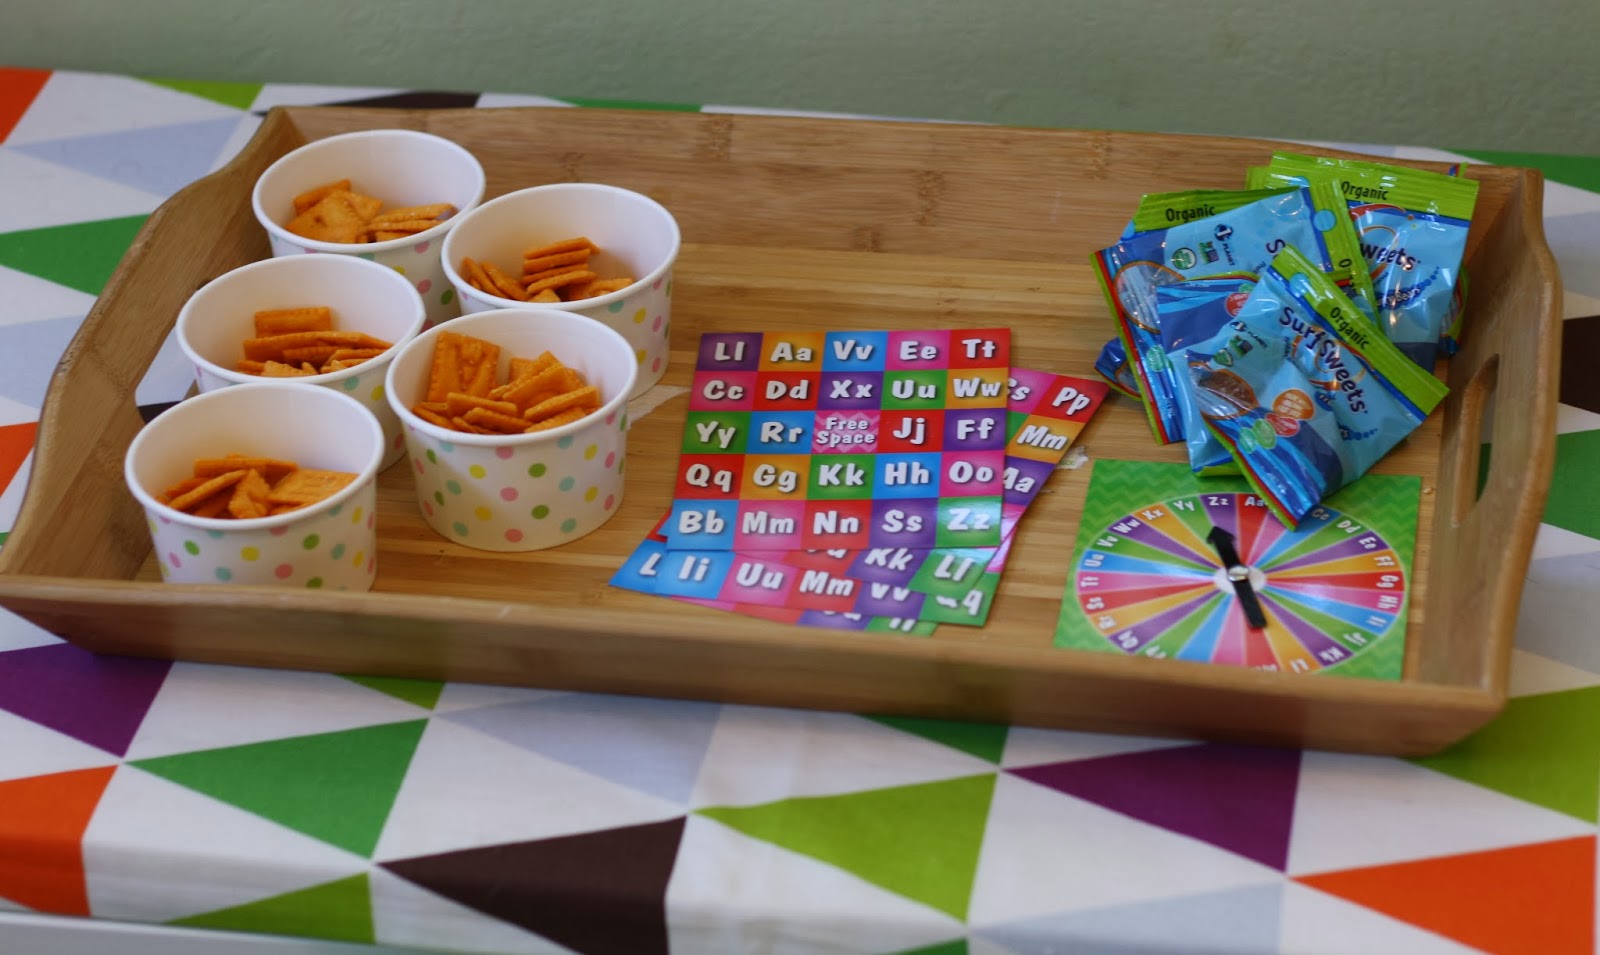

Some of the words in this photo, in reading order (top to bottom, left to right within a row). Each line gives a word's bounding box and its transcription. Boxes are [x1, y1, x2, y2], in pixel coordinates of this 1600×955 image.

[1341, 180, 1388, 201] Organic
[1165, 203, 1217, 222] Organic
[1329, 306, 1370, 350] Organic
[771, 342, 811, 362] Aa
[834, 339, 873, 360] Vv
[899, 340, 937, 360] Ee
[962, 338, 995, 359] Tt
[703, 380, 743, 400] Cc
[766, 379, 808, 400] Dd
[829, 379, 873, 399] Xx
[892, 379, 936, 399] Uu
[953, 377, 1001, 398] Ww
[1052, 386, 1091, 416] Pp
[697, 421, 735, 449] Yy
[761, 421, 802, 443] Rr
[825, 416, 869, 431] Free
[893, 417, 925, 445] Jj
[957, 417, 995, 440] Ff
[815, 429, 875, 448] Space
[1016, 424, 1068, 450] Mm
[686, 463, 731, 492] Qq
[754, 464, 797, 493] Gg
[818, 462, 864, 486] Kk
[884, 461, 929, 485] Hh
[948, 460, 993, 483] Oo
[1207, 496, 1230, 507] Zz
[678, 509, 724, 534] Bb
[742, 510, 794, 534] Mm
[813, 510, 859, 535] Nn
[881, 509, 923, 533] Ss
[946, 505, 997, 531] Zz
[1112, 518, 1142, 535] Ww
[1141, 508, 1165, 522] Xx
[638, 552, 662, 576] L
[735, 562, 785, 591] Uu
[798, 569, 855, 598] Mm
